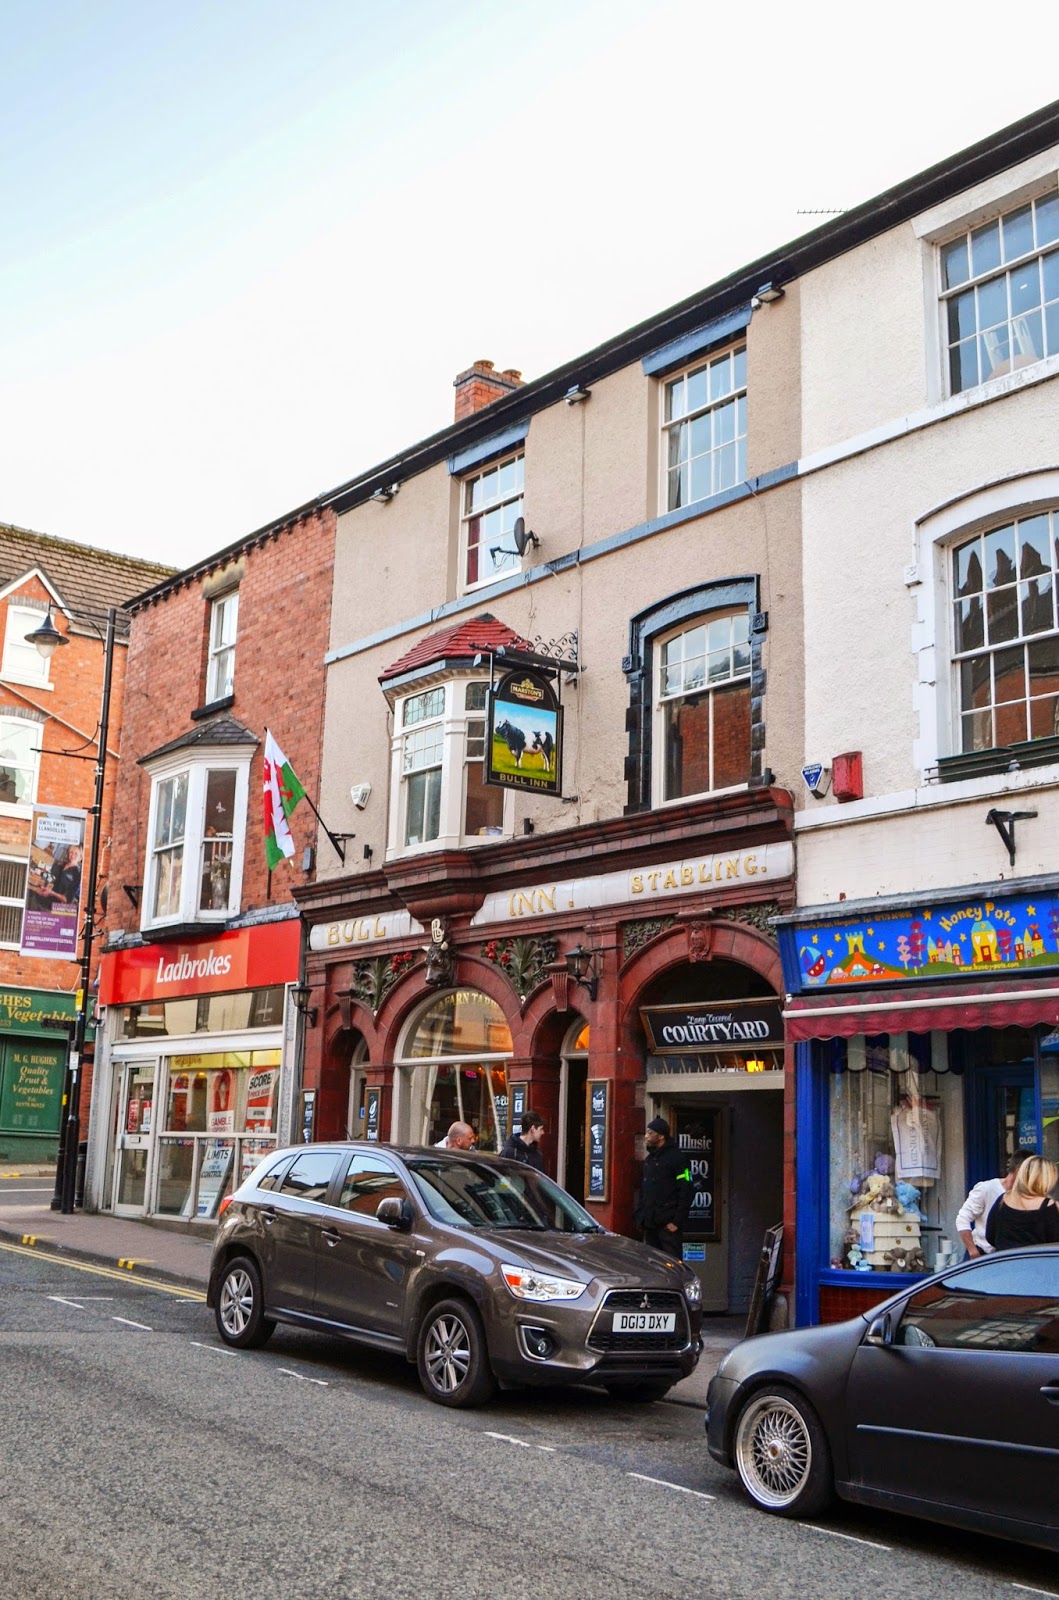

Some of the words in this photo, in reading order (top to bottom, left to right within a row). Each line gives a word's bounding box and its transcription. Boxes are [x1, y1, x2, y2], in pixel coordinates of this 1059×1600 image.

[500, 772, 527, 785] BULL
[529, 778, 548, 789] INN
[938, 906, 983, 932] Honey
[984, 901, 1016, 926] Pots
[327, 917, 387, 945] BULL
[155, 949, 232, 983] Ladbrokes
[0, 994, 32, 1008] HES
[662, 1020, 770, 1043] COURTYARD
[30, 1055, 57, 1065] HUGHES
[20, 1066, 49, 1078] Quality
[19, 1075, 40, 1084] Fruit
[41, 1077, 48, 1085] &
[249, 1073, 272, 1090] SCORE
[12, 1084, 54, 1095] Vegetables
[211, 1117, 232, 1127] GAMBLE
[678, 1134, 712, 1150] Music
[207, 1149, 230, 1161] LIMITS
[201, 1170, 223, 1179] CONTROL
[690, 1160, 708, 1179] BQ
[621, 1315, 646, 1329] DG13
[648, 1315, 669, 1329] DXY
